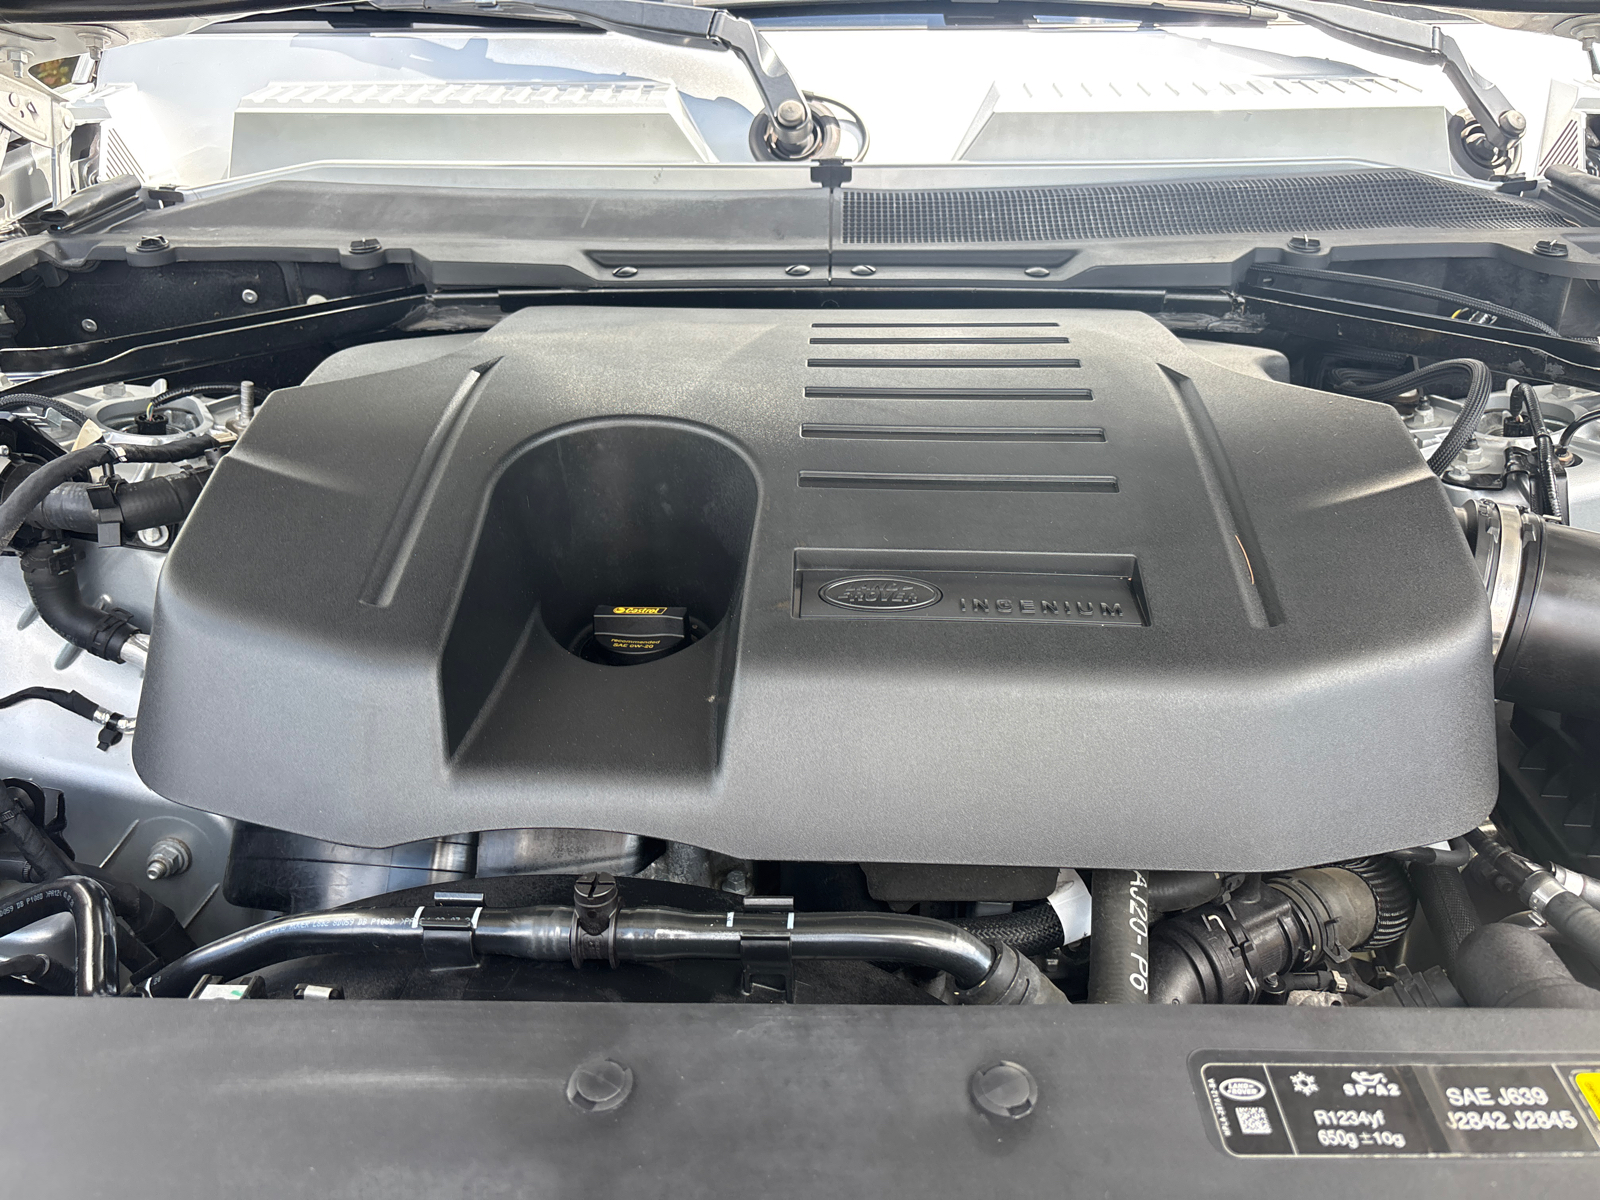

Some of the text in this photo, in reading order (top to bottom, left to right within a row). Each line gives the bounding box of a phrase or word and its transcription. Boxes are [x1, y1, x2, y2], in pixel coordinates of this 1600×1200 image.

[849, 591, 918, 602] ROVER
[960, 598, 1124, 617] INGENIUM
[1342, 1083, 1401, 1097] SP-A2
[1446, 1086, 1549, 1107] SAE J639
[1313, 1109, 1385, 1129] R1234yf
[1446, 1109, 1578, 1131] J2842 J2845
[1317, 1128, 1406, 1150] 650g ±10g
